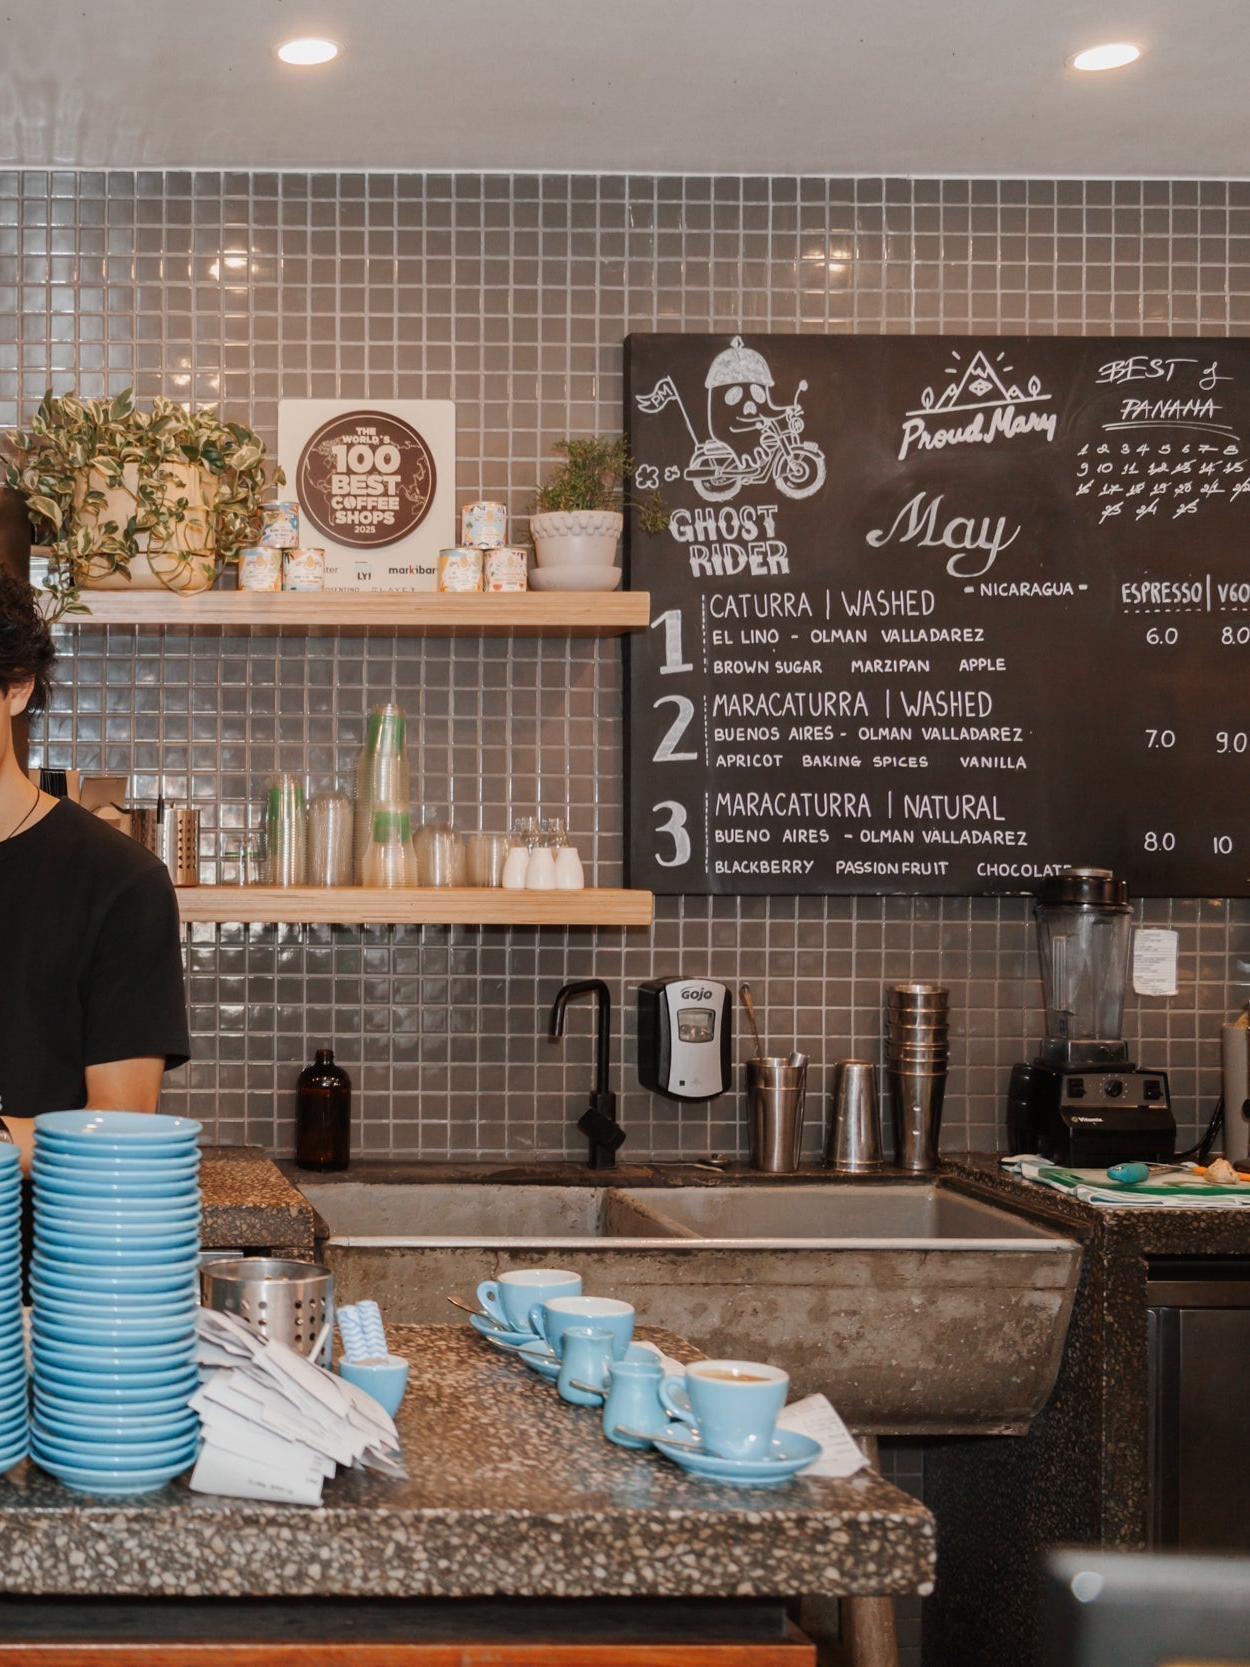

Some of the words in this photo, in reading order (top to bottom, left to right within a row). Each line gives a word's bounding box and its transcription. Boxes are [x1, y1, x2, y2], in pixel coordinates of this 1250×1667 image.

[1095, 356, 1198, 384] BEST
[651, 384, 673, 407] PM
[343, 435, 391, 445] WORLD'S
[356, 427, 377, 436] THE
[898, 417, 982, 460] Proud
[983, 403, 1057, 443] Mary
[332, 444, 401, 474] 100
[1097, 444, 1110, 454] 2
[1121, 444, 1130, 454] 3
[1136, 444, 1149, 456] 4
[1158, 444, 1171, 454] 5
[1182, 444, 1190, 453] 6
[1223, 445, 1238, 455] 8
[1077, 463, 1088, 476] 9
[1097, 463, 1113, 473] 10
[1121, 463, 1139, 475] 11
[332, 474, 401, 495] BEST
[331, 496, 400, 510] COFFEE
[335, 511, 396, 525] SHOPS
[669, 504, 779, 542] GHOST
[866, 491, 1021, 577] May
[690, 541, 790, 578] RIDER
[980, 582, 1074, 597] NICARAGUA
[1122, 582, 1202, 604] ESPRESSO
[1217, 583, 1250, 603] V60
[709, 591, 813, 619] CATURRA
[841, 589, 935, 617] WASHED
[650, 609, 694, 675] 1
[712, 629, 734, 646] EL
[741, 629, 780, 645] LINO
[810, 629, 868, 644] OLMAN
[880, 627, 985, 644] VALLADAREZ
[1146, 627, 1178, 645] 6.0
[1221, 626, 1250, 645] 8.0
[713, 659, 770, 675] BROWN
[774, 659, 823, 674] SUGAR
[850, 658, 930, 674] MARZIPAN
[958, 658, 1007, 673] APPLE
[712, 690, 869, 718] MARACATURRA
[899, 689, 993, 718] WASHED
[652, 694, 699, 763] 2
[713, 726, 781, 742] BUENOS
[788, 726, 835, 741] AIRES
[857, 726, 912, 741] OLMAN
[921, 726, 1024, 742] VALLADAREZ
[1145, 728, 1176, 749] 7.0
[1215, 731, 1248, 754] 9.0
[715, 753, 784, 768] APRICOT
[801, 754, 863, 768] BAKING
[872, 755, 929, 769] SPICES
[959, 755, 1028, 770] VANILLA
[715, 791, 872, 819] MARACATURRA
[903, 793, 1006, 822] NATURAL
[651, 799, 692, 868] 3
[714, 828, 771, 844] BUENO
[782, 828, 830, 844] AIRES
[859, 829, 915, 844] OLMAN
[921, 829, 1029, 847] VALLADAREZ
[1143, 831, 1176, 852] 8.0
[1213, 835, 1233, 855] 10
[714, 859, 815, 875] BLACKBERRY
[977, 862, 1072, 878] CHOCOLAT
